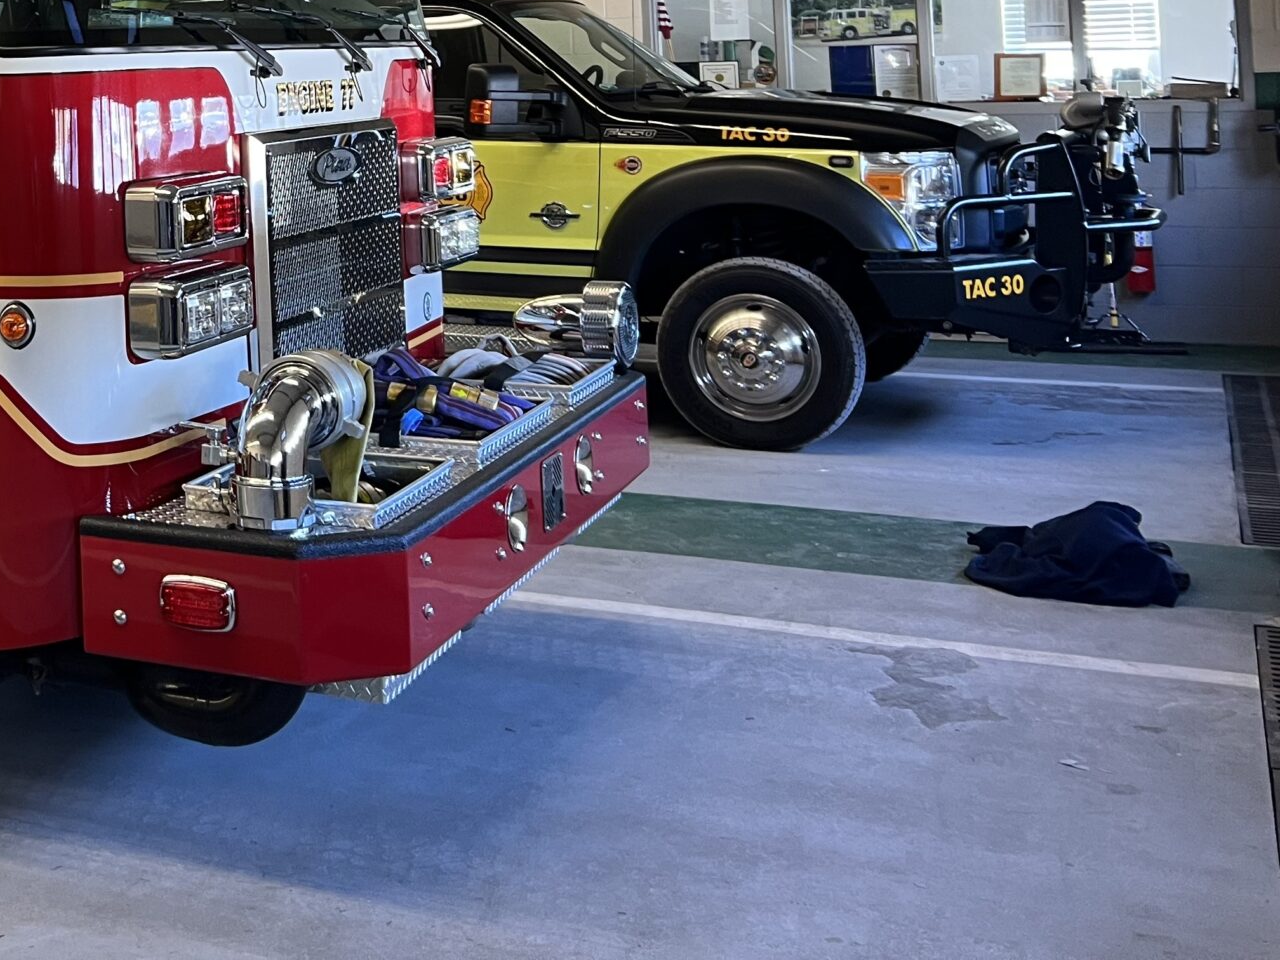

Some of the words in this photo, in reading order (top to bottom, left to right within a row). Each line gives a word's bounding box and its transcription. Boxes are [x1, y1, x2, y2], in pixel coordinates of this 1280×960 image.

[276, 81, 334, 116] ENGINE
[340, 79, 356, 110] 77
[719, 126, 757, 141] TAC
[762, 127, 790, 142] 30
[962, 277, 997, 300] TAC
[1001, 273, 1024, 296] 30
